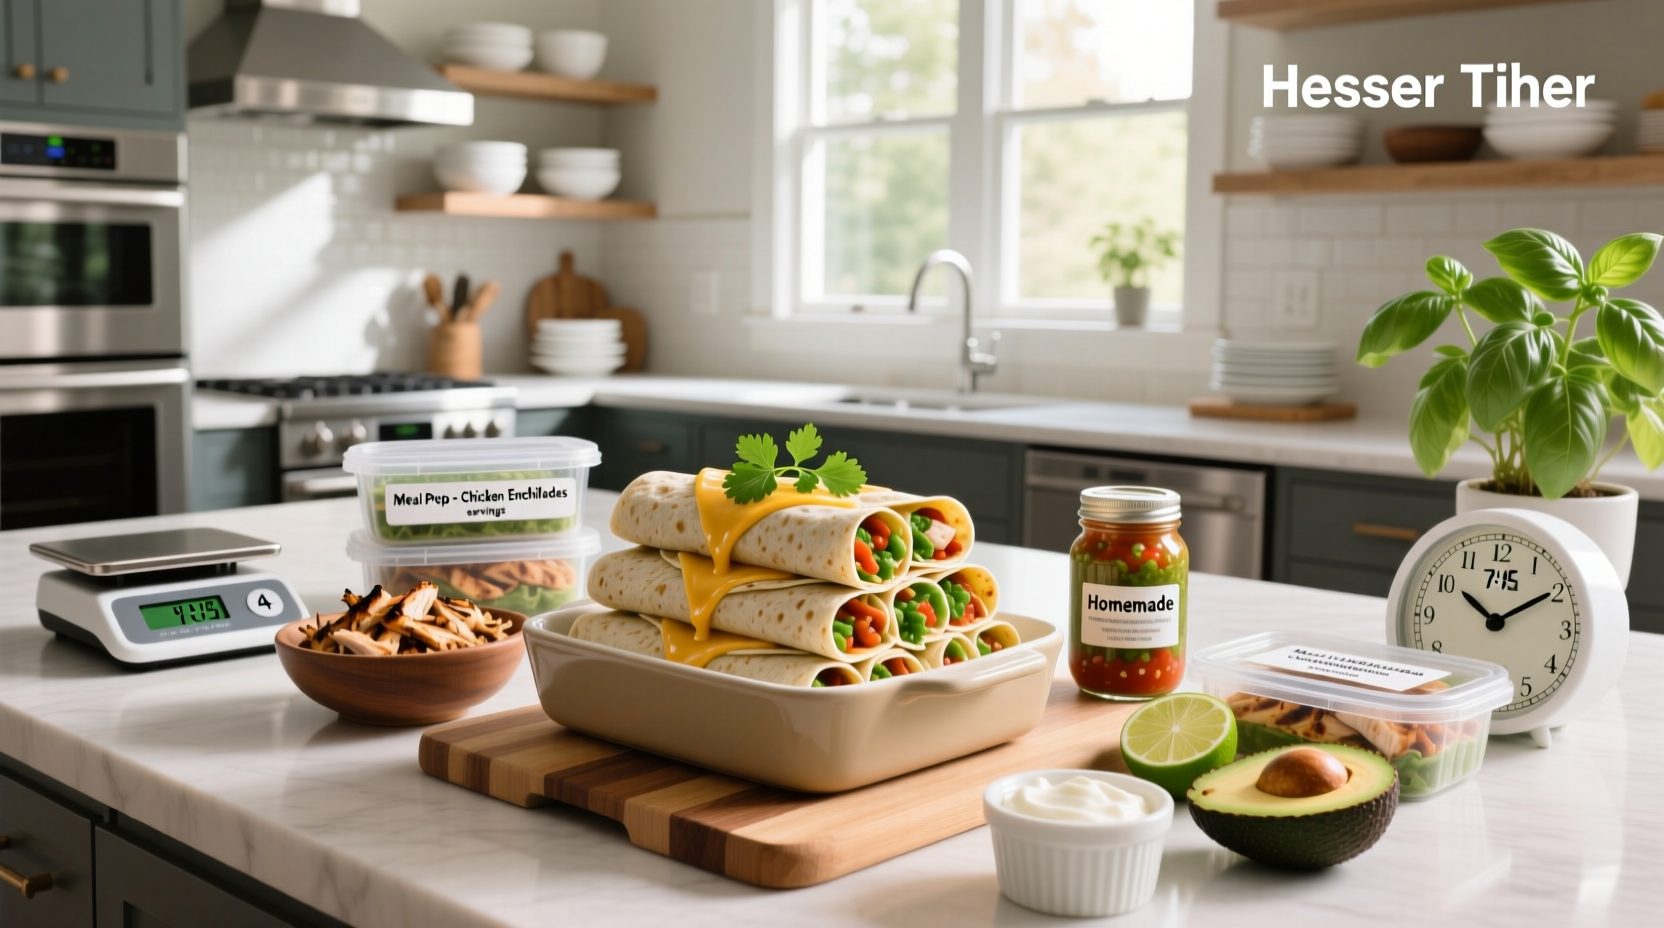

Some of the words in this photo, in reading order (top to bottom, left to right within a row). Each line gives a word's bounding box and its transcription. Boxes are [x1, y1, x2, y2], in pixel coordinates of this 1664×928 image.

[393, 492, 422, 506] Meal
[461, 489, 504, 503] Chicken
[1461, 551, 1476, 570] 11
[1491, 543, 1512, 563] 12
[1530, 556, 1538, 575] 1
[1437, 574, 1455, 594] 10
[1483, 568, 1518, 591] 7:15
[258, 593, 273, 610] 4
[1551, 582, 1564, 603] 2
[1087, 593, 1174, 613] Homemade
[1423, 605, 1435, 625] 9
[1559, 619, 1572, 641] 3
[1543, 654, 1558, 674] 4
[1520, 676, 1532, 697] 5
